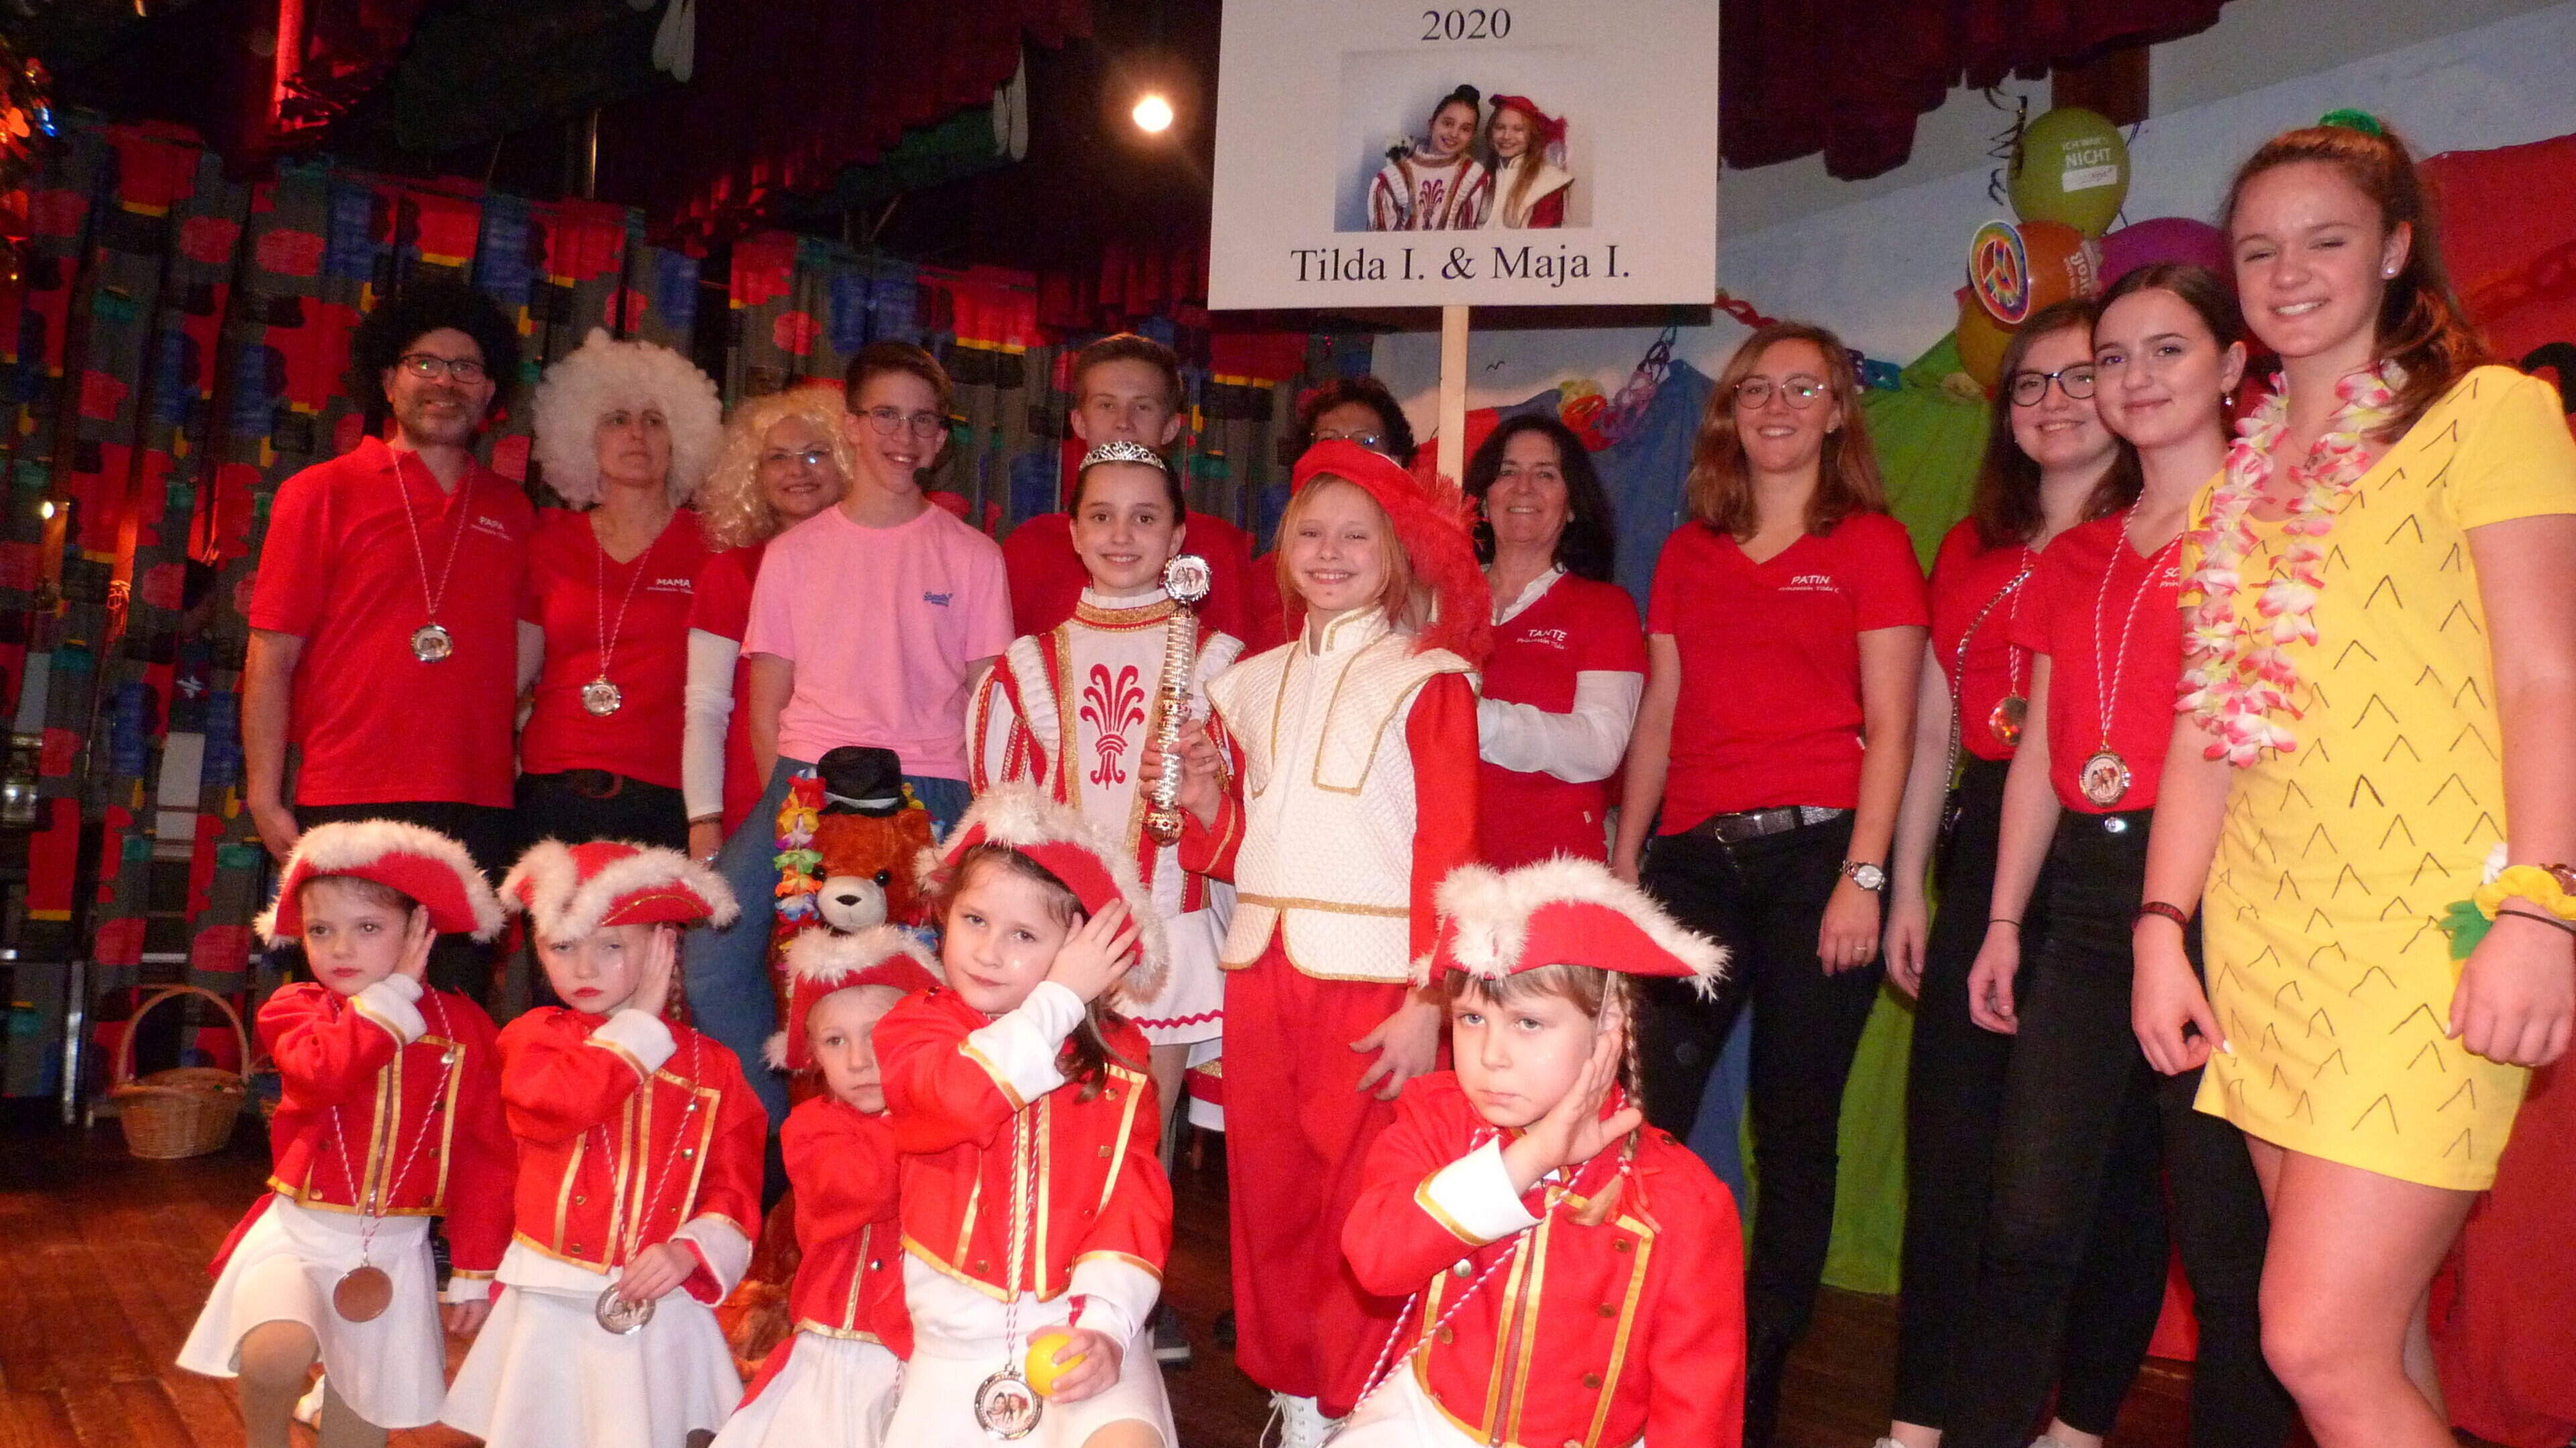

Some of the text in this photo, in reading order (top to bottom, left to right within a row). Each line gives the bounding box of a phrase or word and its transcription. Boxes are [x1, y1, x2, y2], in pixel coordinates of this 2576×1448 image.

[1421, 8, 1511, 41] 2020
[2065, 148, 2111, 168] NICHT
[1291, 244, 1630, 288] Tilda I. & Maja I.
[478, 516, 506, 532] PAPA
[655, 578, 691, 589] MAMA
[1790, 575, 1831, 585] PATIN
[1527, 628, 1567, 642] TANTE
